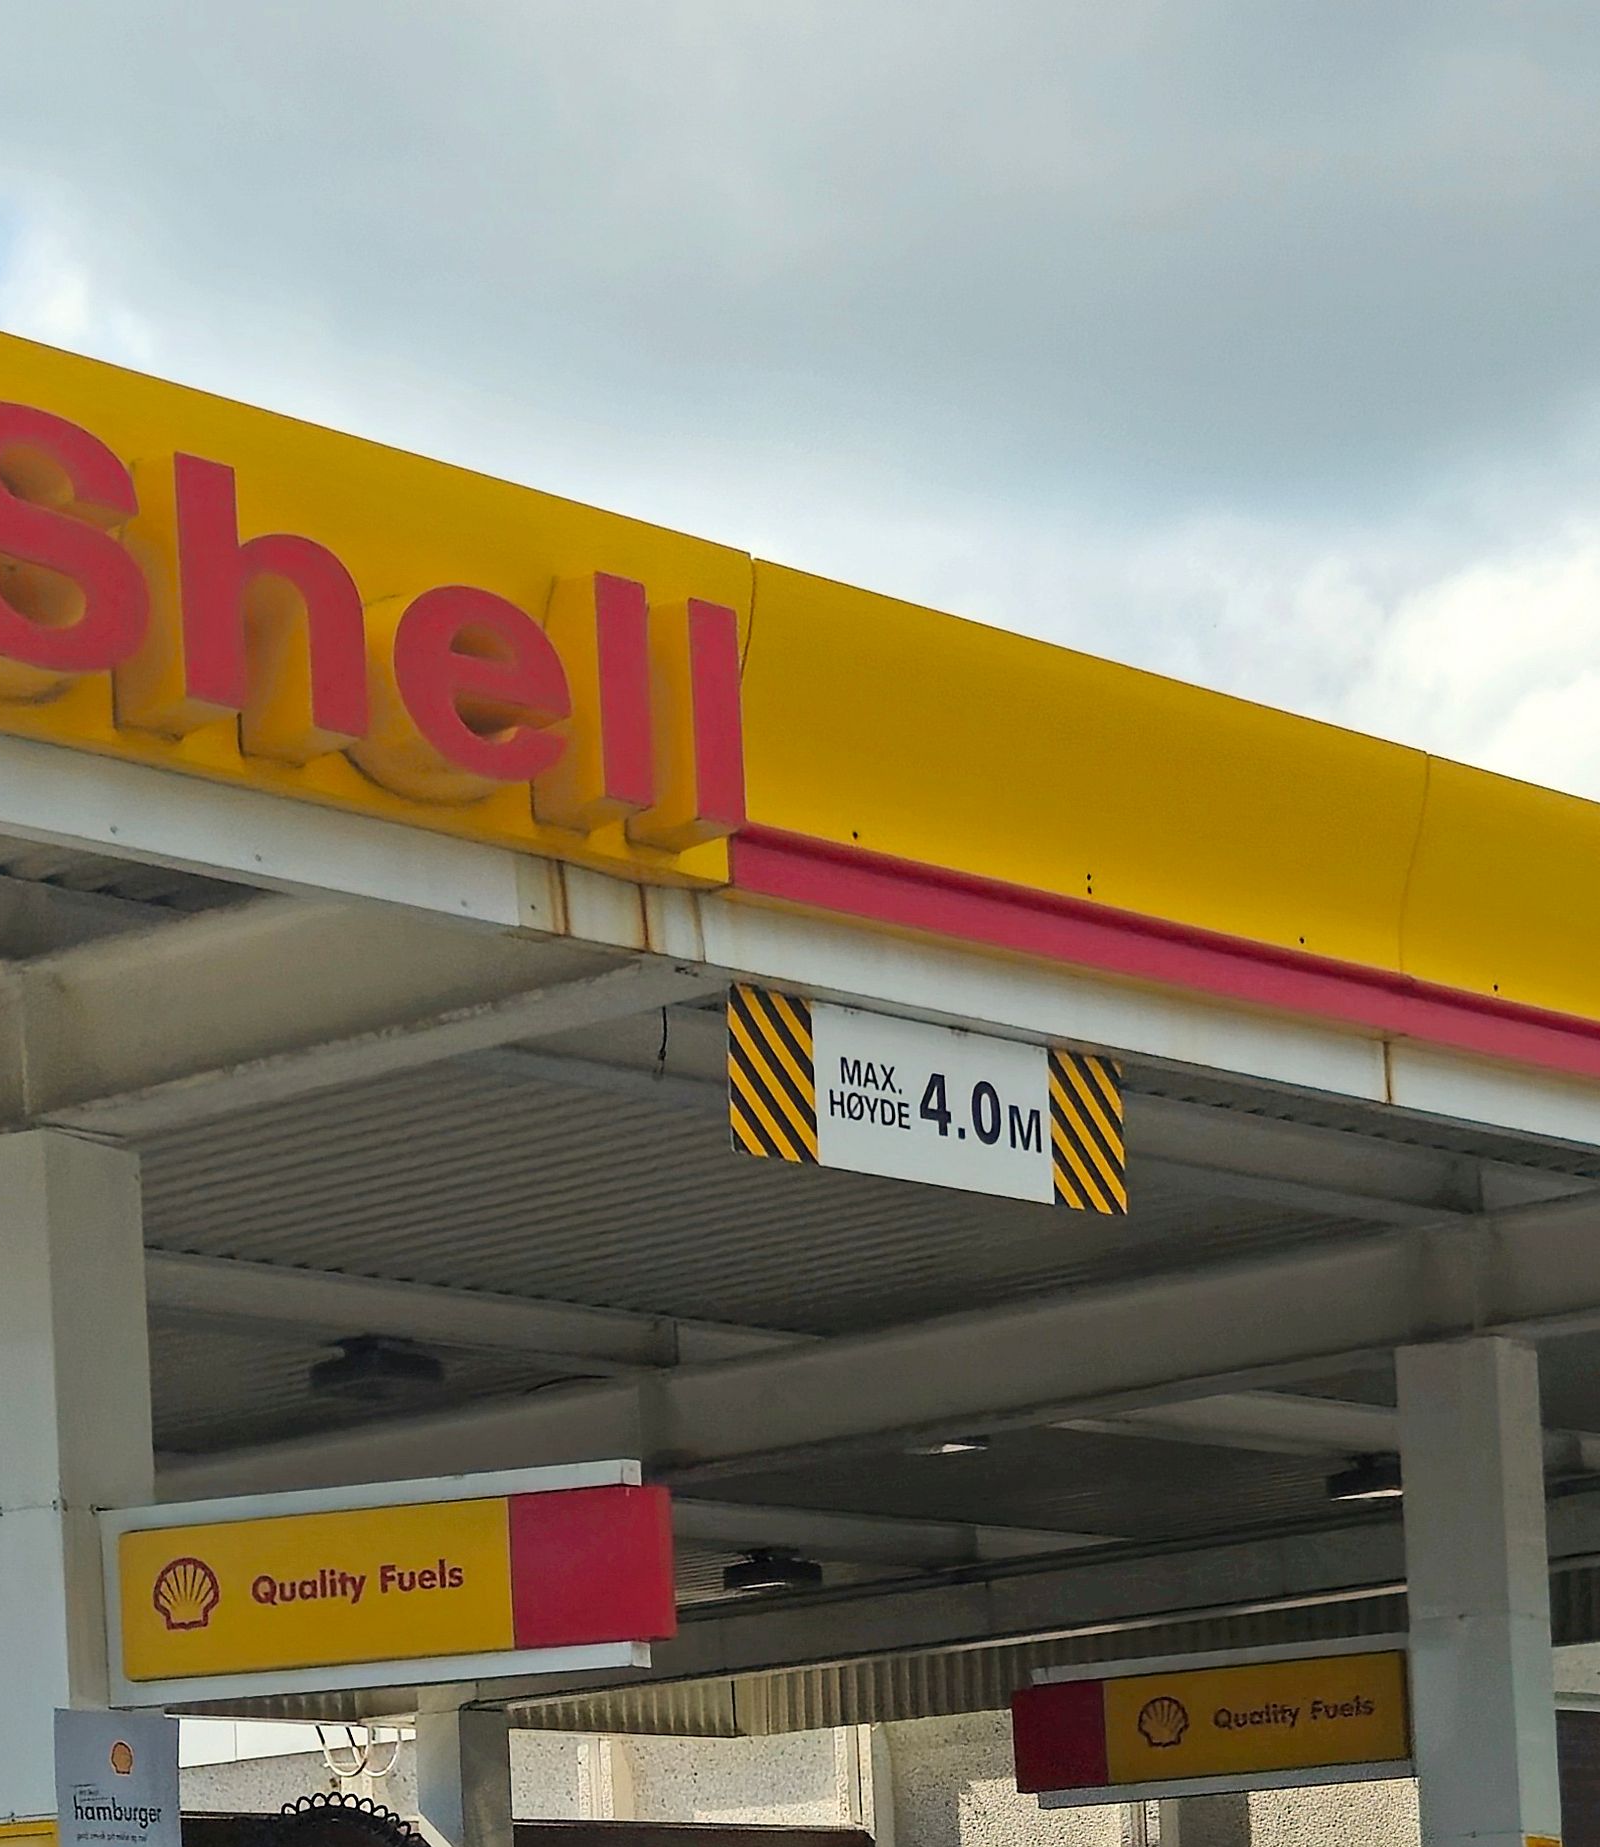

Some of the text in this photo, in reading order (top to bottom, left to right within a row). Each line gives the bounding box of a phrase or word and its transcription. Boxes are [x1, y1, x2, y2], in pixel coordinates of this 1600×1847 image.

[840, 1056, 903, 1095] MAX.
[828, 1089, 911, 1130] HØYDE
[250, 1557, 466, 1609] Quality Fuels
[1213, 1695, 1375, 1729] Quality Fuels
[73, 1795, 161, 1829] hamburger
